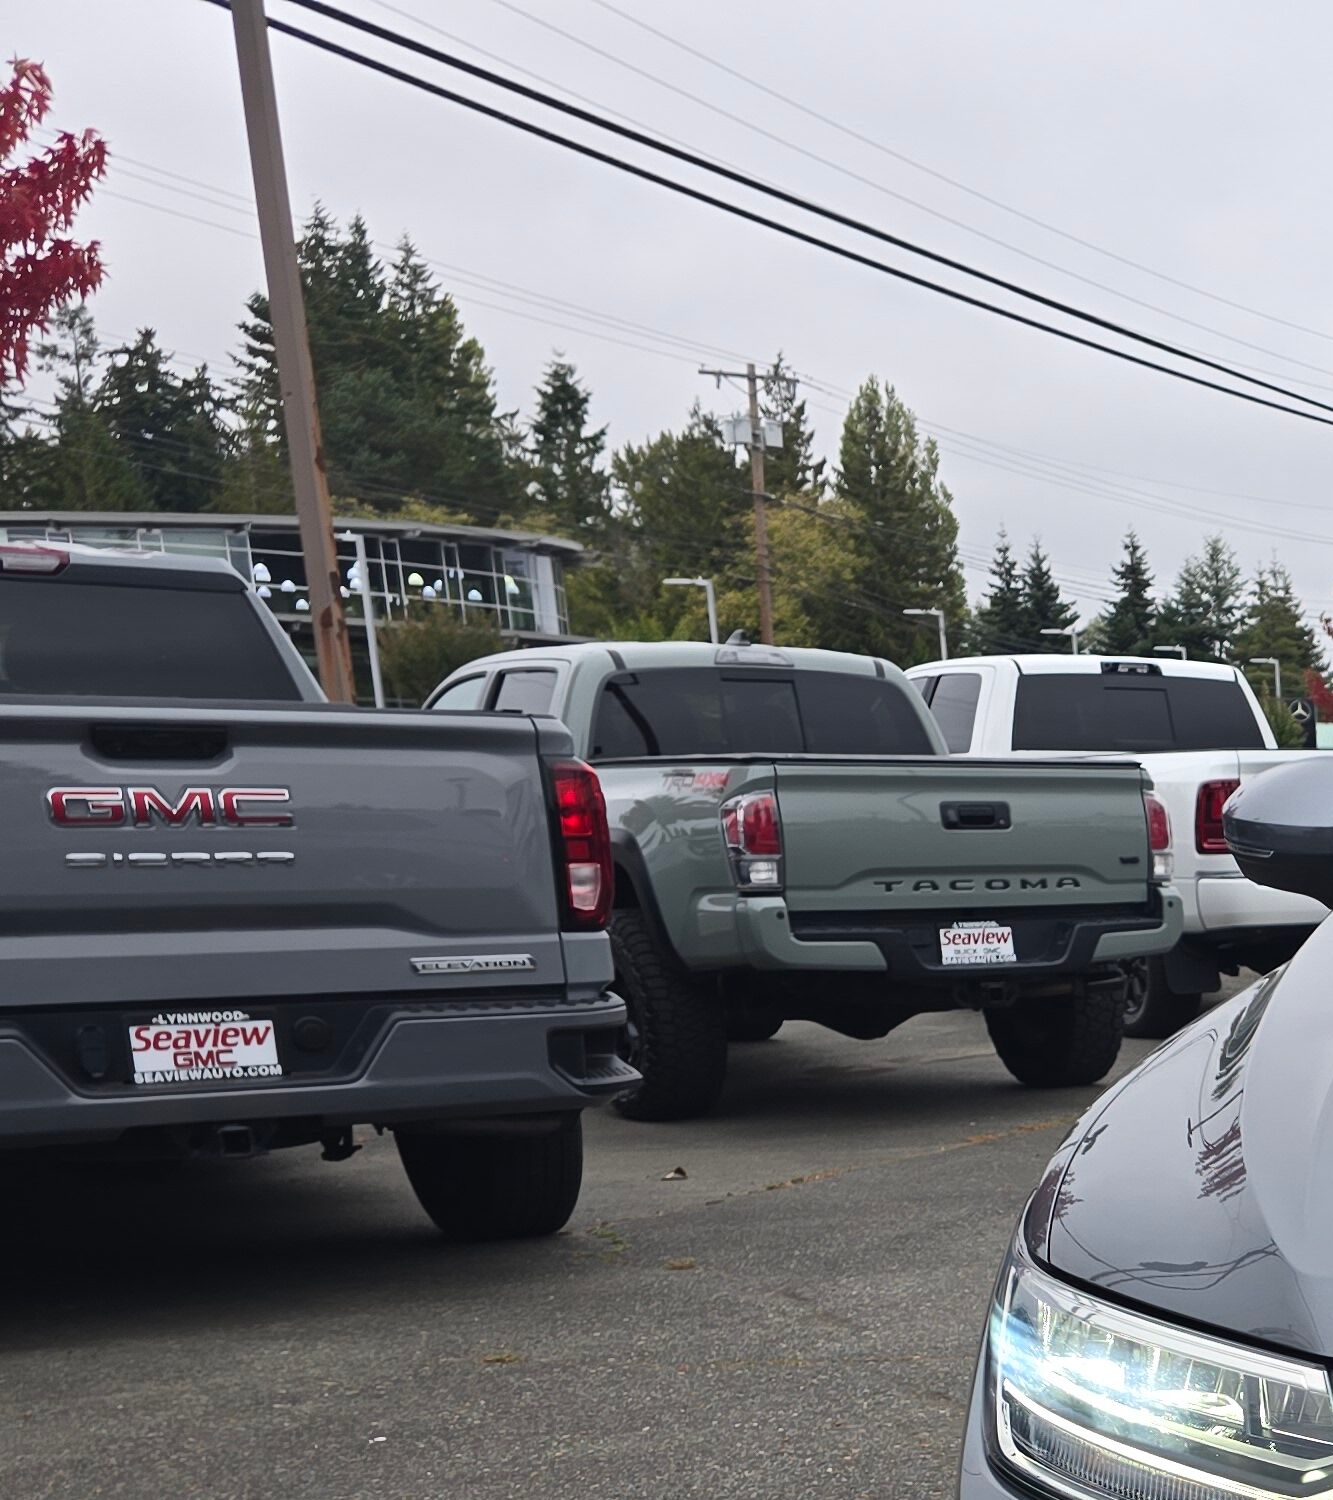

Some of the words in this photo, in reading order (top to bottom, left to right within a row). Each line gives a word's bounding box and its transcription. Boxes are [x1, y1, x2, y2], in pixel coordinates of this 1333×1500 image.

[46, 786, 294, 828] GMC
[873, 876, 1082, 893] TACOMA
[942, 929, 1010, 946] Seaview
[421, 959, 526, 970] ELEVATION
[157, 1011, 245, 1025] LYNNWOOD
[133, 1024, 271, 1052] Seaview
[173, 1049, 237, 1068] GMC
[134, 1064, 282, 1084] SEAVIEWAUTO.COM
